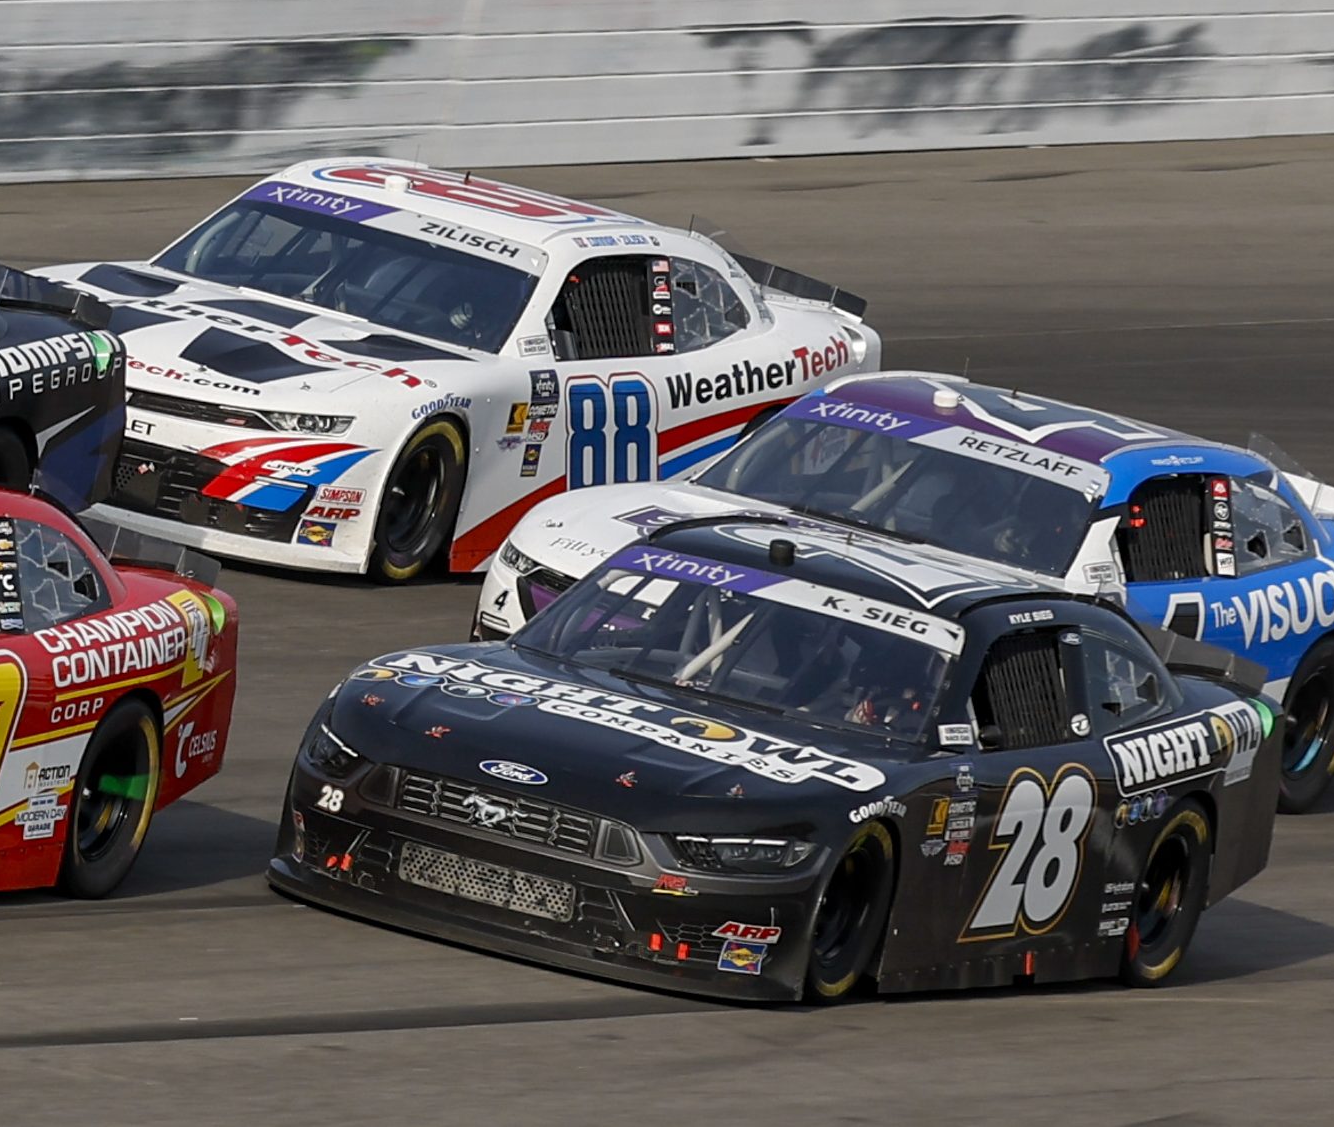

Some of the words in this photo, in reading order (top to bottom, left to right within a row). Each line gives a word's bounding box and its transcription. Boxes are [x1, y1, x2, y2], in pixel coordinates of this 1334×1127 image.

[267, 185, 364, 214] xfinity
[419, 221, 520, 259] ZILISCH
[667, 335, 850, 411] WeatherTech
[567, 375, 657, 489] 88
[809, 402, 911, 431] xfinity
[958, 435, 1082, 476] RETZLAFF
[320, 488, 363, 504] SIMPSON
[306, 506, 361, 520] ARP
[633, 553, 746, 586] xfinity
[493, 590, 510, 612] 4
[821, 595, 851, 614] K.
[862, 605, 929, 637] SIEG
[1210, 601, 1237, 628] The
[34, 598, 181, 655] CHAMPION
[1008, 612, 1033, 625] KYLE
[54, 626, 189, 688] CONTAINER
[387, 652, 664, 716] NIGHT
[51, 697, 105, 724] CORP
[188, 729, 218, 758] CELSIUS
[543, 700, 802, 782] COMPANIES
[1111, 721, 1211, 788] NIGHT
[490, 763, 536, 782] Ford
[316, 784, 345, 812] 28
[957, 762, 1098, 944] 28
[716, 922, 781, 940] ARP
